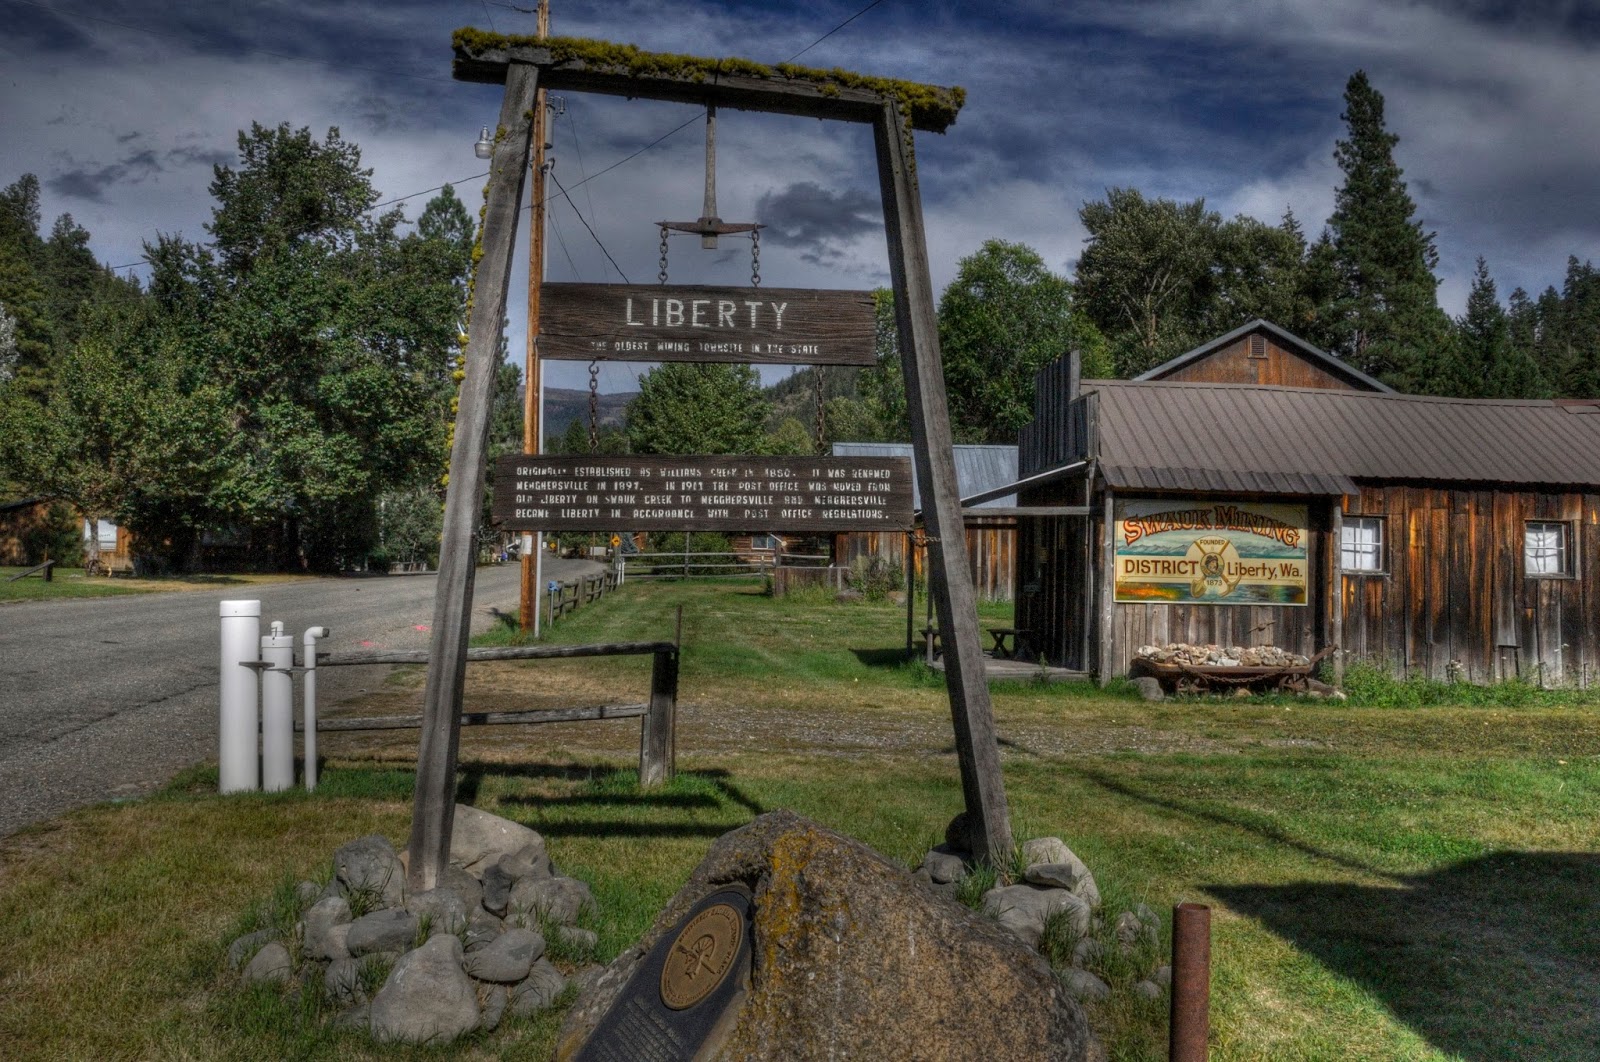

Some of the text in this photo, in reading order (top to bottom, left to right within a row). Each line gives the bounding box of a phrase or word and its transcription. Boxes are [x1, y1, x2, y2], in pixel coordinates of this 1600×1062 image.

[626, 298, 788, 331] LIBERTY
[614, 341, 649, 353] OLDEST
[656, 341, 690, 354] MINING
[698, 342, 743, 355] TOWNSITE
[751, 343, 761, 354] IN
[767, 343, 784, 355] THE
[790, 343, 820, 356] STATE
[516, 466, 567, 477] ORIGINALLY
[574, 466, 632, 477] ESTABLISHED
[639, 467, 651, 477] AS
[660, 467, 702, 477] WILLIAMS
[812, 468, 820, 477] IT
[827, 468, 846, 479] WAS
[852, 468, 891, 479] RENAMED
[597, 481, 607, 491] IN
[665, 481, 675, 491] IN
[712, 481, 729, 491] THE
[738, 481, 762, 491] POST
[769, 481, 800, 492] OFFICE
[808, 481, 827, 492] WAS
[833, 482, 862, 492] MOVED
[867, 482, 891, 492] FROM
[540, 494, 578, 504] LIBERTY
[586, 495, 598, 504] ON
[605, 494, 636, 505] SWAUK
[644, 495, 672, 505] CREEK
[680, 495, 692, 505] TO
[515, 508, 550, 519] BECAME
[561, 508, 600, 519] LIBERTY
[611, 509, 621, 519] IN
[633, 509, 695, 519] ACCORDANCE
[707, 509, 729, 519] WITH
[744, 509, 769, 519] POST
[781, 509, 813, 520] OFFICE
[1122, 505, 1301, 549] SWAUK MINING
[1124, 558, 1303, 580] DISTRICT Liberty, Wa.
[1206, 579, 1223, 587] 1873
